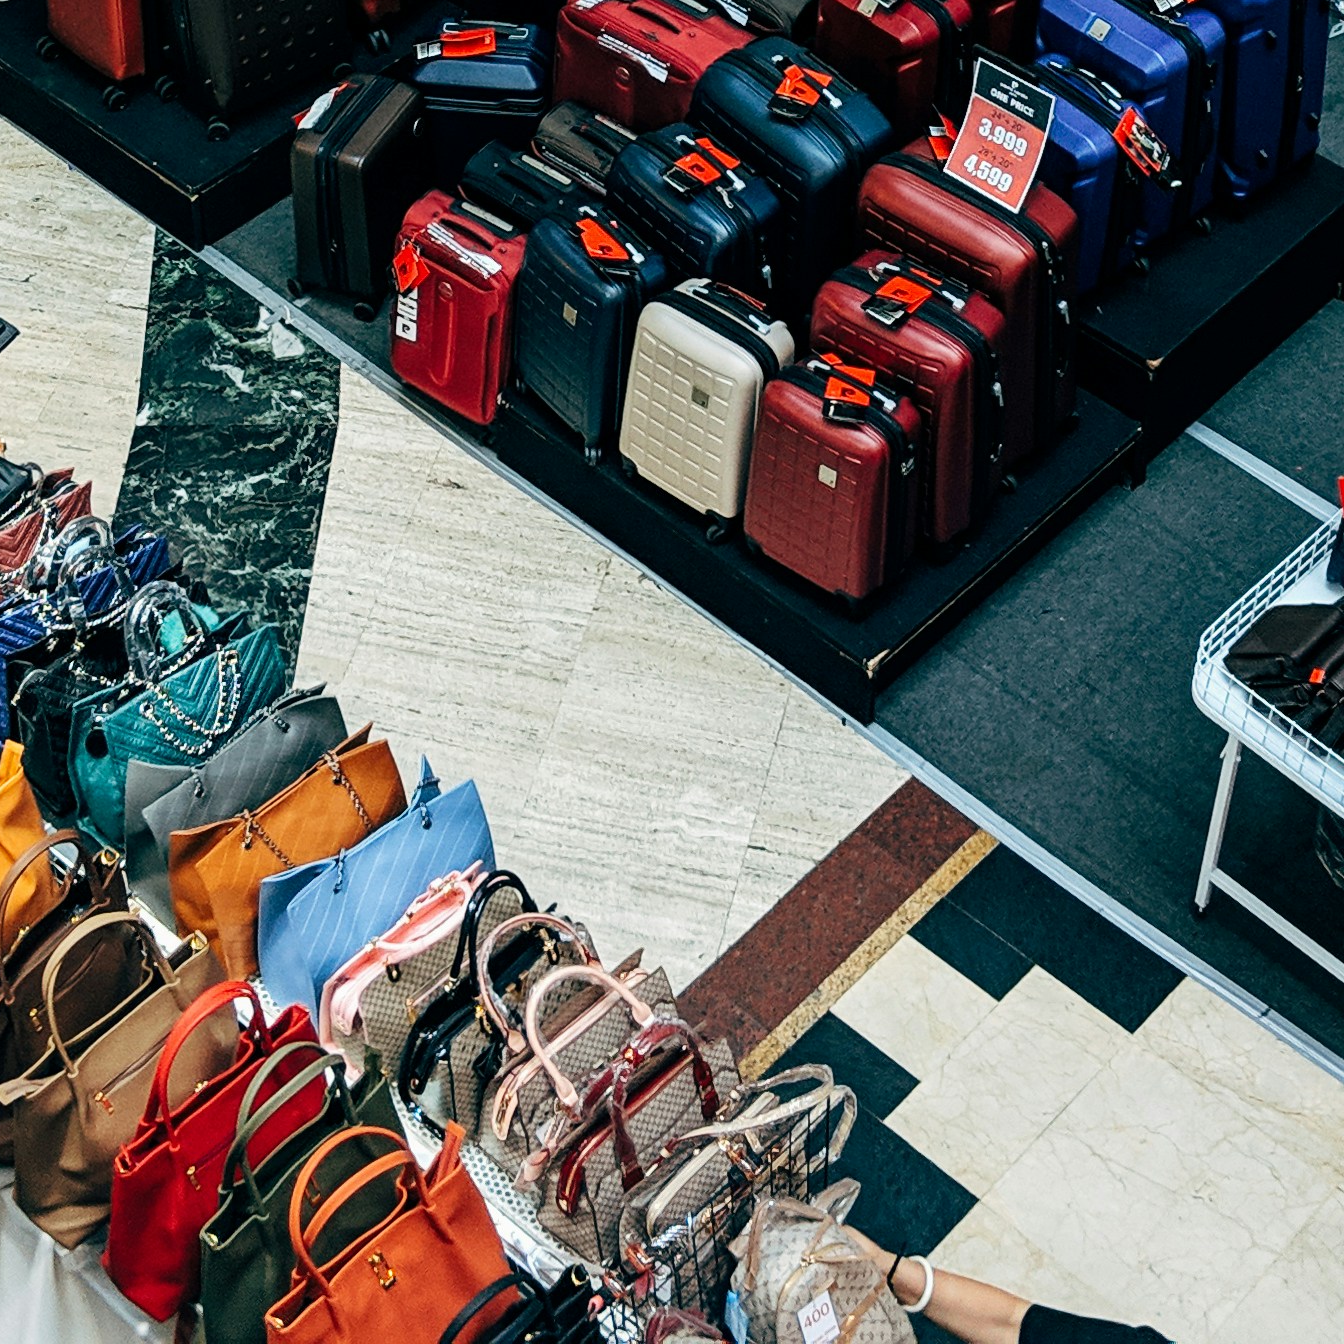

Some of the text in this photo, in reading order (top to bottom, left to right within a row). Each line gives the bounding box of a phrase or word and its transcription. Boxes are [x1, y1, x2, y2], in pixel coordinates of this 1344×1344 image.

[990, 87, 1009, 103] ONE
[1009, 98, 1035, 118] PRICE
[978, 117, 1028, 157] 3,999
[963, 154, 1013, 193] 4,599
[804, 1302, 830, 1328] 400
